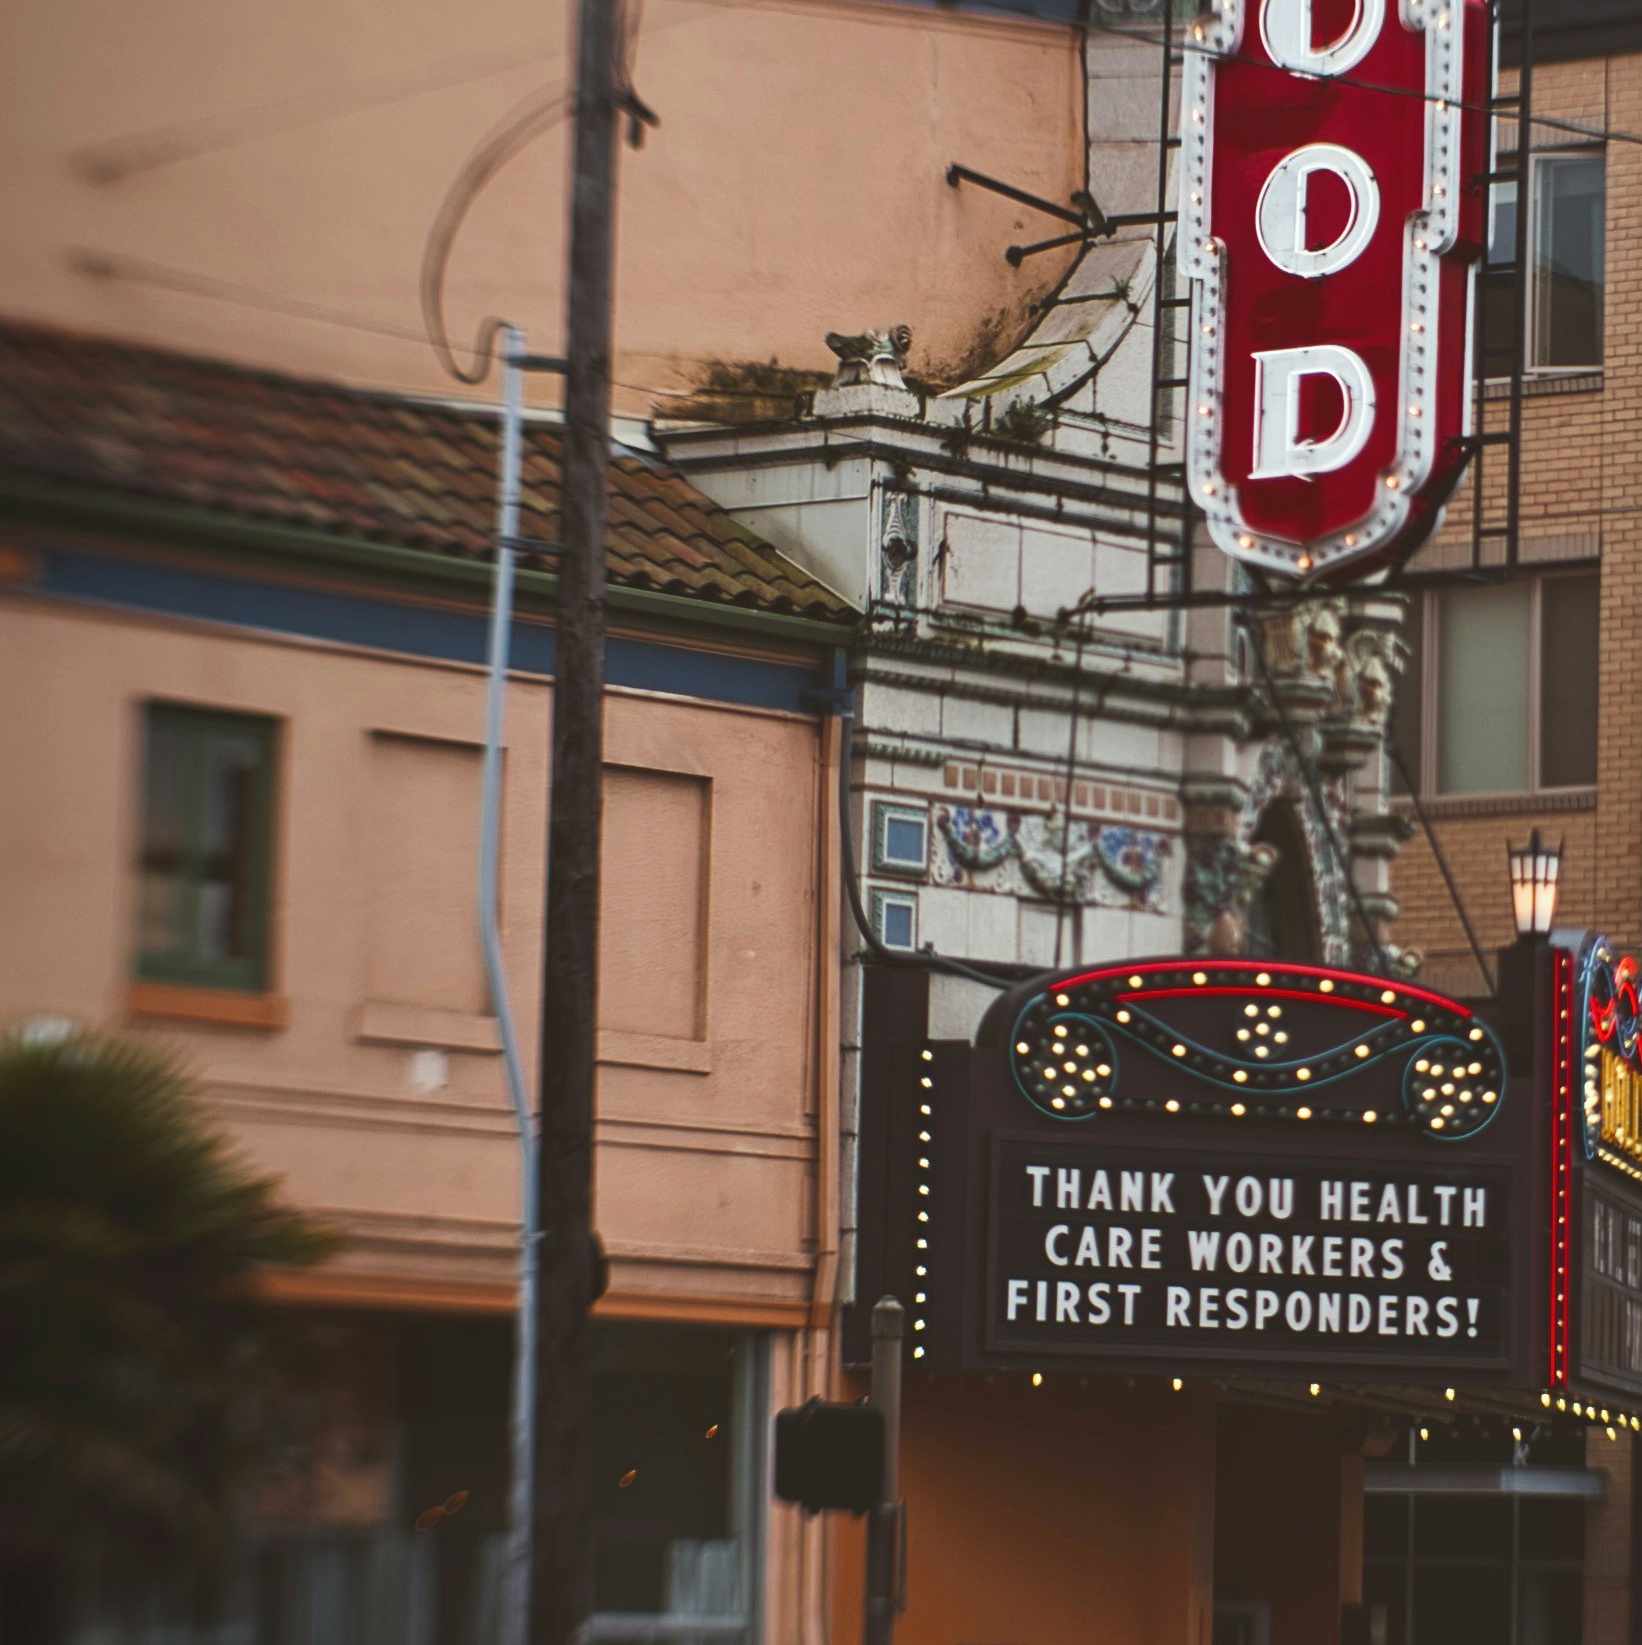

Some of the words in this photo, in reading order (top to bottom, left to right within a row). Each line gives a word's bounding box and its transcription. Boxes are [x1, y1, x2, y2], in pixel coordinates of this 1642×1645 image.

[1024, 1164, 1176, 1215] THANK
[1202, 1174, 1295, 1221] YOU
[1320, 1180, 1486, 1229] HEALTH
[1043, 1224, 1163, 1271] CARE
[1187, 1229, 1405, 1281] WORKERS
[1427, 1240, 1453, 1283] &
[1006, 1278, 1143, 1327] FIRST
[1166, 1284, 1481, 1339] RESPONDERS!
